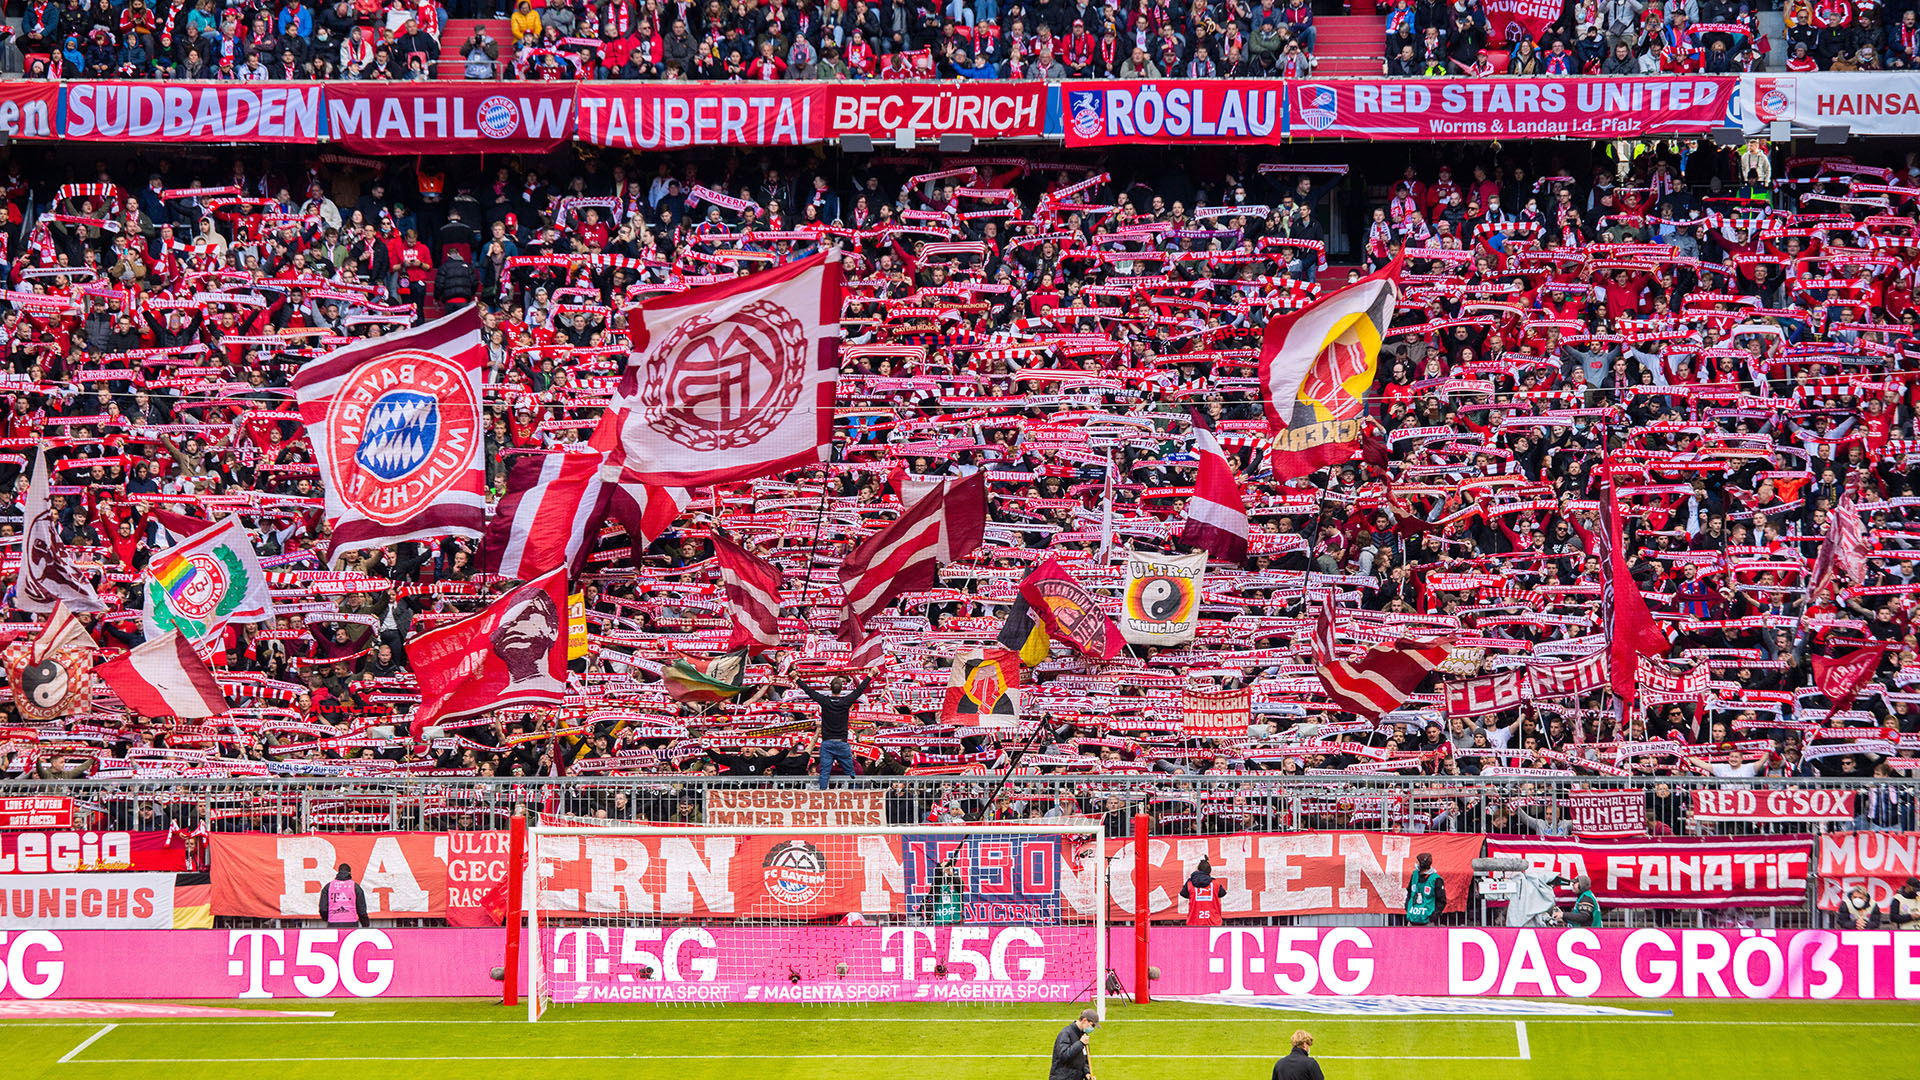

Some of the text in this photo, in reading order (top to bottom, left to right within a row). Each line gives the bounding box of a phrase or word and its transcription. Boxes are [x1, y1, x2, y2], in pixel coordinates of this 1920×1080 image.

[1354, 82, 1720, 113] RED STARS UNITED
[1818, 94, 1920, 116] HAINSA
[0, 98, 51, 138] en
[67, 84, 319, 138] SÜDBADEN
[581, 95, 821, 147] TAUBERTAL
[833, 92, 1038, 130] BFC ZÜRICH
[1107, 84, 1277, 136] RÖSLAU
[1430, 119, 1487, 134] Worms
[1489, 120, 1504, 133] &
[1508, 120, 1568, 133] Landau
[1602, 119, 1641, 131] Pfalz
[1488, 503, 1533, 517] SÜDKURVE
[260, 629, 299, 640] AYERN
[1182, 695, 1249, 711] SCHICKERIA
[1183, 710, 1249, 728] MÜNCHEN
[701, 735, 792, 749] SCHICKERIA
[1571, 807, 1645, 823] JUNGS!
[1697, 790, 1851, 817] RED G'SOX
[708, 810, 883, 827] IMMER BEI UNS
[276, 835, 736, 917] BAERN
[1199, 911, 1210, 919] 25
[0, 929, 65, 1000] G
[293, 929, 394, 998] 5G
[616, 927, 718, 983] 5G
[1273, 927, 1375, 995] 5G
[1448, 928, 1602, 997] DAS
[594, 985, 729, 999] MAGENTA SPORT
[764, 985, 900, 999] MAGENTA SPORT
[934, 985, 1070, 999] MAGENTA SPORT
